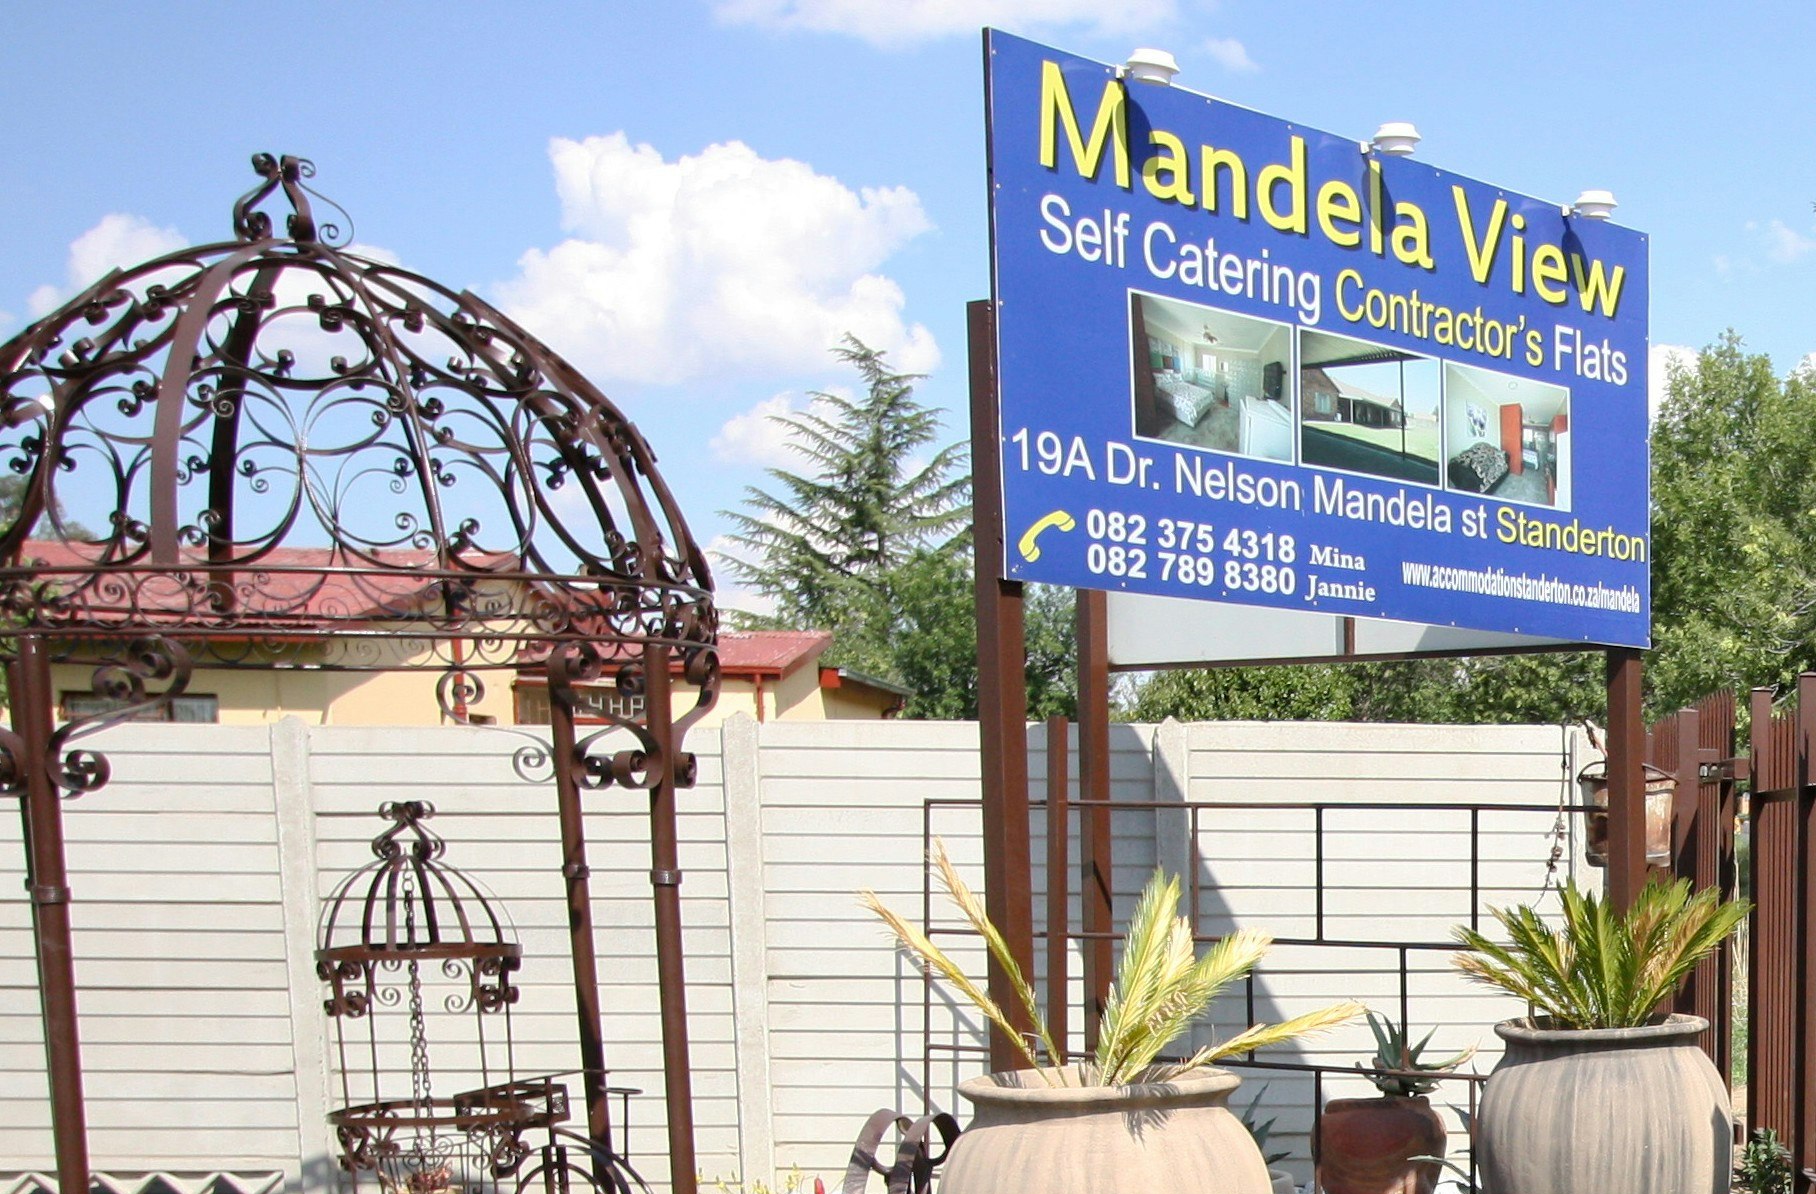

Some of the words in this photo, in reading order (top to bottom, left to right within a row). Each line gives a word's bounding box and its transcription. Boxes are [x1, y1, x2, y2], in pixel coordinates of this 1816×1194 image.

[1038, 59, 1434, 269] Mandela
[1452, 185, 1625, 318] View
[1040, 193, 1130, 269] Self
[1143, 221, 1320, 325] Catering
[1335, 268, 1544, 367] Contractor's
[1554, 324, 1628, 386] Flats
[1012, 428, 1095, 480] 19A
[1107, 441, 1160, 490] Dr.
[1175, 453, 1301, 510] Nelson
[1314, 474, 1452, 534] Mandela
[1462, 503, 1488, 540] st
[1496, 506, 1646, 563] Standerton
[1086, 508, 1147, 545] 082
[1157, 518, 1215, 553] 375
[1222, 527, 1296, 564] 4318
[1309, 543, 1366, 572] Mina
[1086, 543, 1147, 579] 082
[1157, 551, 1215, 587] 789
[1223, 559, 1296, 595] 8380
[1305, 574, 1377, 602] Jannie
[1402, 561, 1641, 614] www.accommodationstanderton.co.za/mandela
